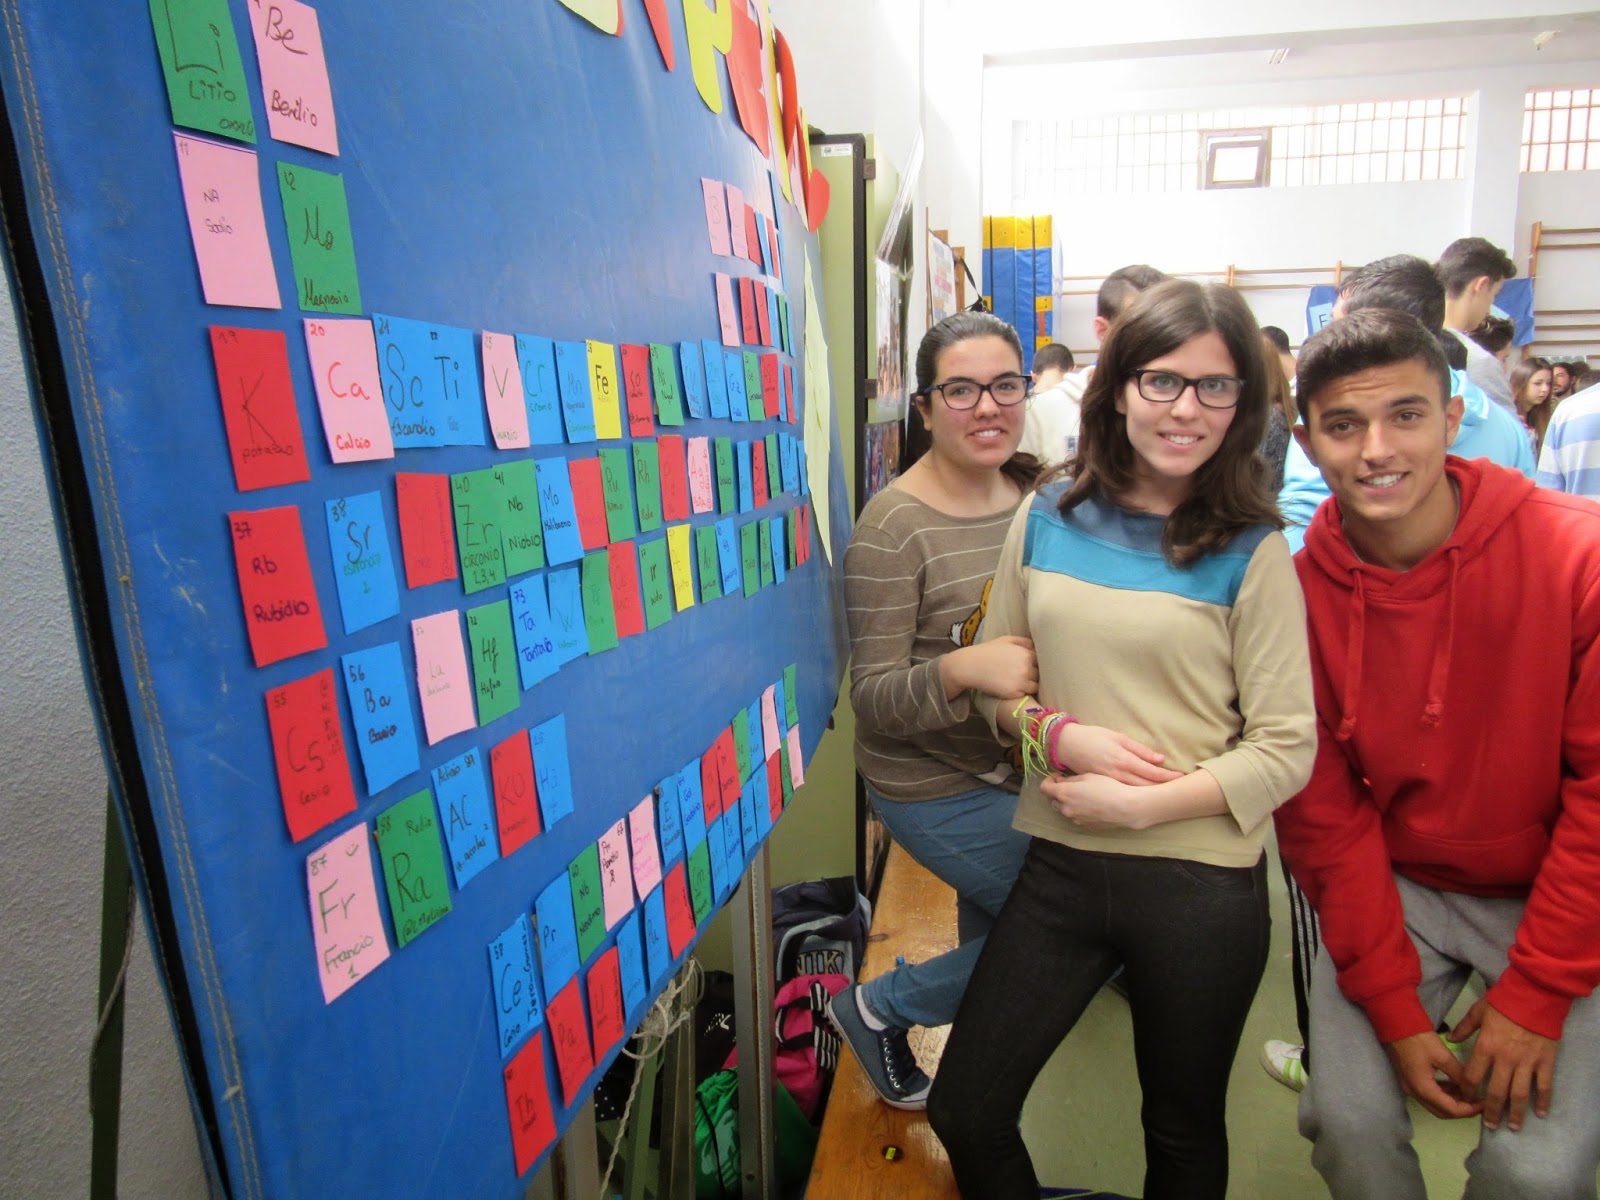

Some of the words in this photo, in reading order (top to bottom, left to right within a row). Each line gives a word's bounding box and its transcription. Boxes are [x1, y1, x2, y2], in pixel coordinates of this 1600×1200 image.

[266, 6, 308, 55] Be
[310, 322, 325, 337] 20
[327, 361, 370, 400] Ca
[386, 342, 424, 412] Sc
[433, 355, 460, 400] Ti
[491, 364, 509, 399] V
[524, 359, 545, 398] Cr
[595, 364, 609, 395] Fe
[241, 370, 278, 446] K
[336, 433, 371, 450] Calcio
[454, 475, 470, 494] 40
[508, 495, 523, 513] Nb
[346, 520, 371, 564] Sr
[457, 503, 495, 546] Zr
[252, 554, 278, 576] Rb
[519, 610, 537, 632] Ta
[349, 664, 366, 683] 56
[364, 687, 392, 713] Ba
[286, 725, 325, 773] Cs
[310, 853, 328, 877] 87
[392, 851, 433, 913] Ra
[318, 878, 356, 934] Fr
[543, 925, 558, 949] Pr
[796, 949, 845, 976] NIK
[501, 962, 521, 1014] Ce
